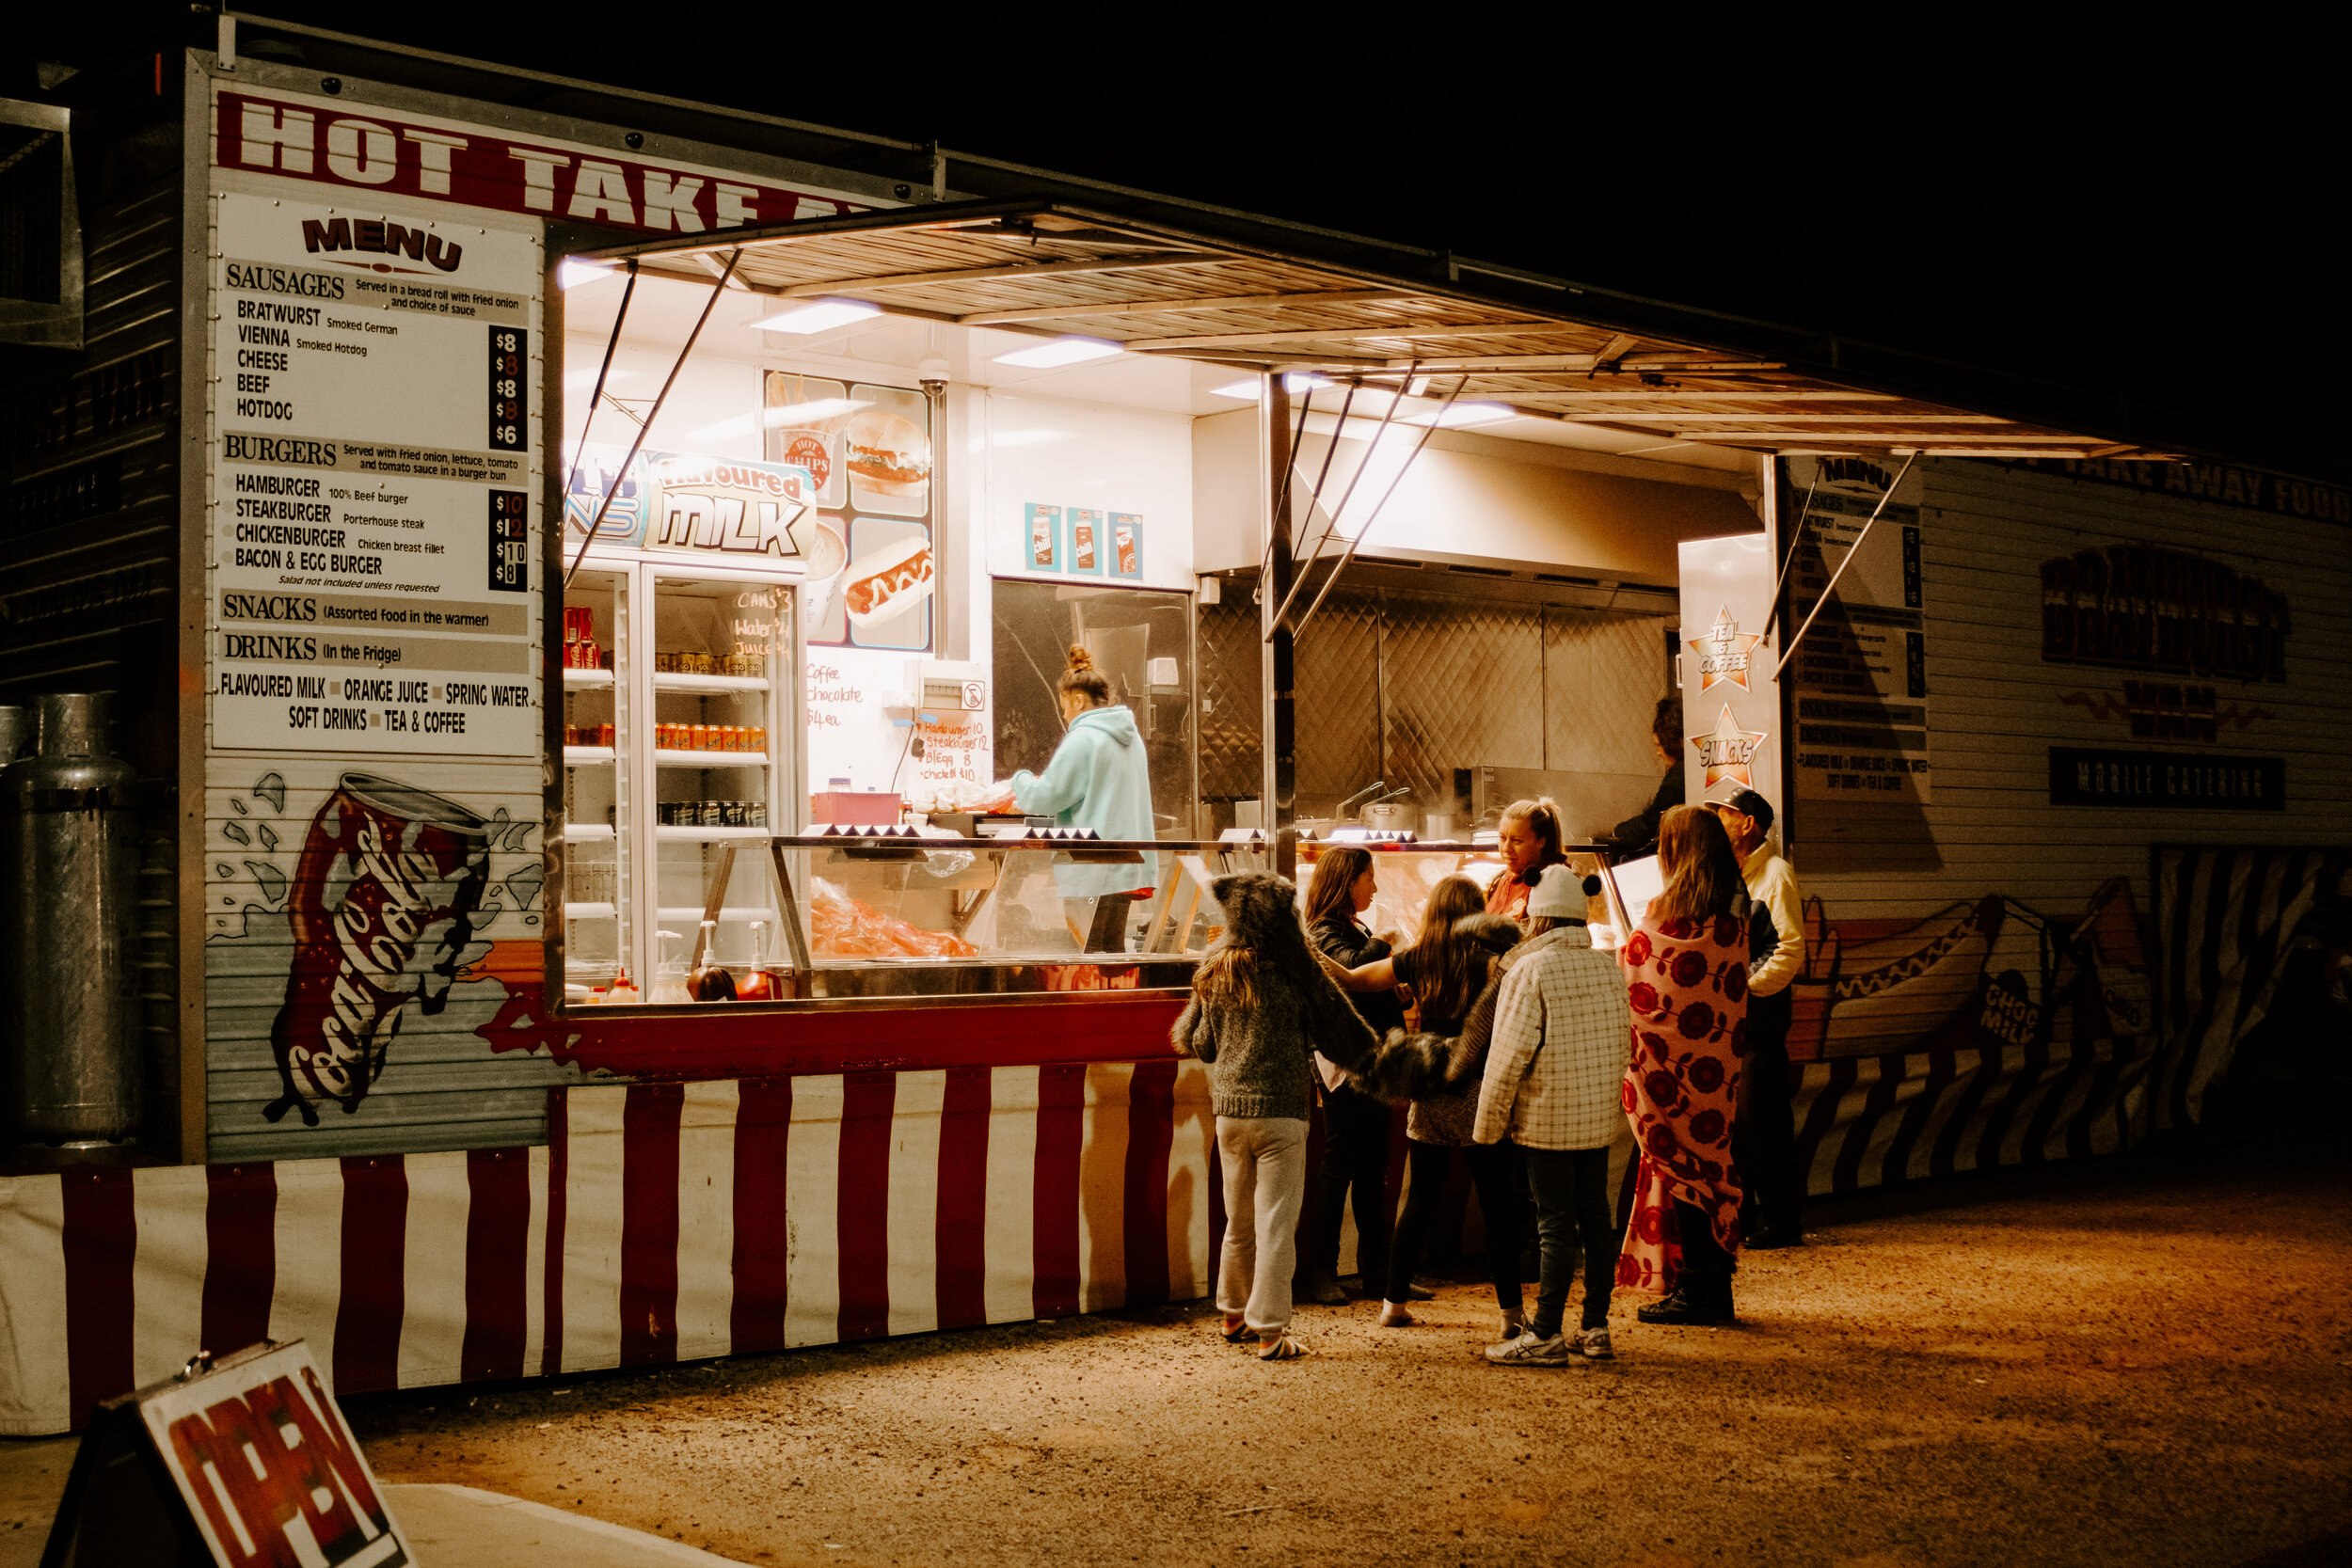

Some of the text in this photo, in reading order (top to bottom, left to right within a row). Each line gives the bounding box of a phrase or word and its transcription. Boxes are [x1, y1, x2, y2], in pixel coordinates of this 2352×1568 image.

[241, 101, 468, 195] HOT
[302, 217, 462, 272] MENU
[227, 263, 344, 300] SAUSAGES
[356, 279, 387, 293] Served
[389, 283, 397, 293] in
[407, 286, 432, 298] bread
[434, 290, 448, 300] roll
[451, 292, 469, 303] with
[472, 293, 493, 306] fried
[496, 298, 518, 309] onion
[237, 300, 397, 335] BRATWURST Smoked German
[391, 298, 475, 316] and choice of sauce
[238, 325, 367, 356] VIENNA Smoked Hotdog
[497, 333, 516, 353] $8
[237, 349, 288, 372] CHEESE
[497, 355, 517, 376] $8
[238, 373, 269, 393] BEEF
[497, 379, 516, 399] $8
[237, 398, 293, 420] HOTDOG
[497, 400, 517, 421] $8
[497, 425, 516, 444] $6
[797, 440, 818, 451] HOT
[224, 435, 336, 467] BURGERS
[343, 444, 517, 469] Served with fried onion, lettuce, tomato
[360, 460, 376, 469] and
[378, 461, 410, 472] tomato
[413, 465, 437, 475] sauce
[440, 466, 449, 475] in
[458, 467, 487, 480] burger
[490, 470, 506, 481] bun
[660, 460, 803, 504] avoured
[1823, 458, 1892, 492] MENU
[2165, 459, 2263, 506] AWAY
[236, 474, 408, 505] HAMBURGER 100% Beef burger
[236, 499, 424, 529] STEAKBURGER Porterhouse steak
[236, 523, 444, 554] CHICKENBURGER Chicken breast fillet
[236, 548, 382, 575] BACON & EGG BURGER
[497, 564, 515, 583] $8
[278, 576, 304, 584] Salad
[324, 578, 363, 588] included
[364, 581, 392, 590] unless
[394, 584, 440, 593] requested
[224, 594, 488, 626] SNACKS (Assorted food in the warmer)
[737, 593, 777, 610] CANS
[735, 618, 772, 637] Water
[1710, 622, 1739, 642] TEA
[225, 634, 401, 664] DRINKS (In the Fridge)
[1698, 650, 1750, 673] COFFEE
[221, 673, 529, 707] FLAVOURED MILK ORANGE JUICE SPRING WATER
[290, 705, 465, 733] SOFT DRINKS TEA & COFFEE
[963, 753, 971, 767] 8
[1700, 739, 1754, 768] SNACKS
[2077, 761, 2154, 797] MOBILE
